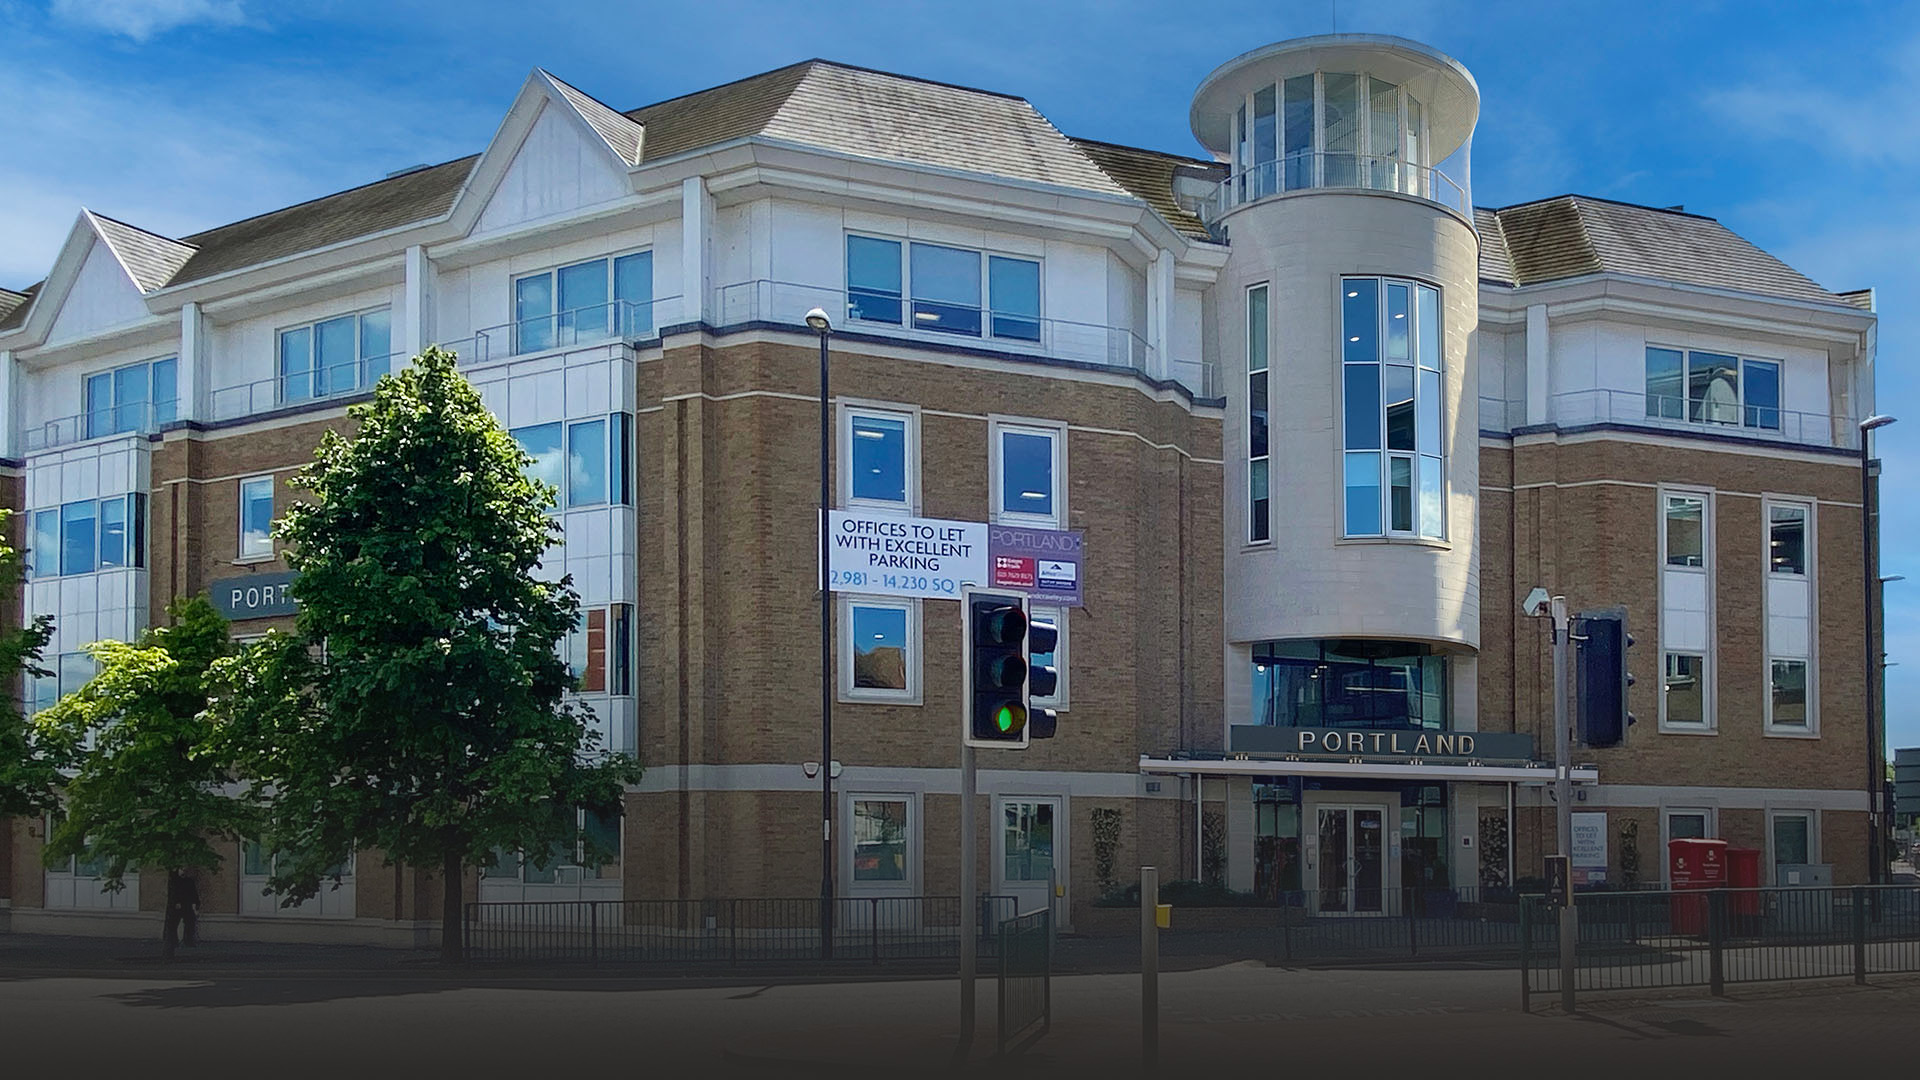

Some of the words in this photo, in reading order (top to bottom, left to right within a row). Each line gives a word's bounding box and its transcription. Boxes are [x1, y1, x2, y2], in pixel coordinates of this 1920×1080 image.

[842, 519, 907, 538] OFFICES
[912, 525, 935, 540] TO
[940, 527, 966, 542] LET
[991, 529, 1074, 551] PORTLAND
[835, 534, 880, 551] WITH
[885, 539, 972, 558] EXCELLENT
[869, 553, 940, 571] PARKING
[831, 570, 867, 586] 2,981
[932, 578, 955, 594] SQ
[1298, 731, 1475, 755] PORTLAND
